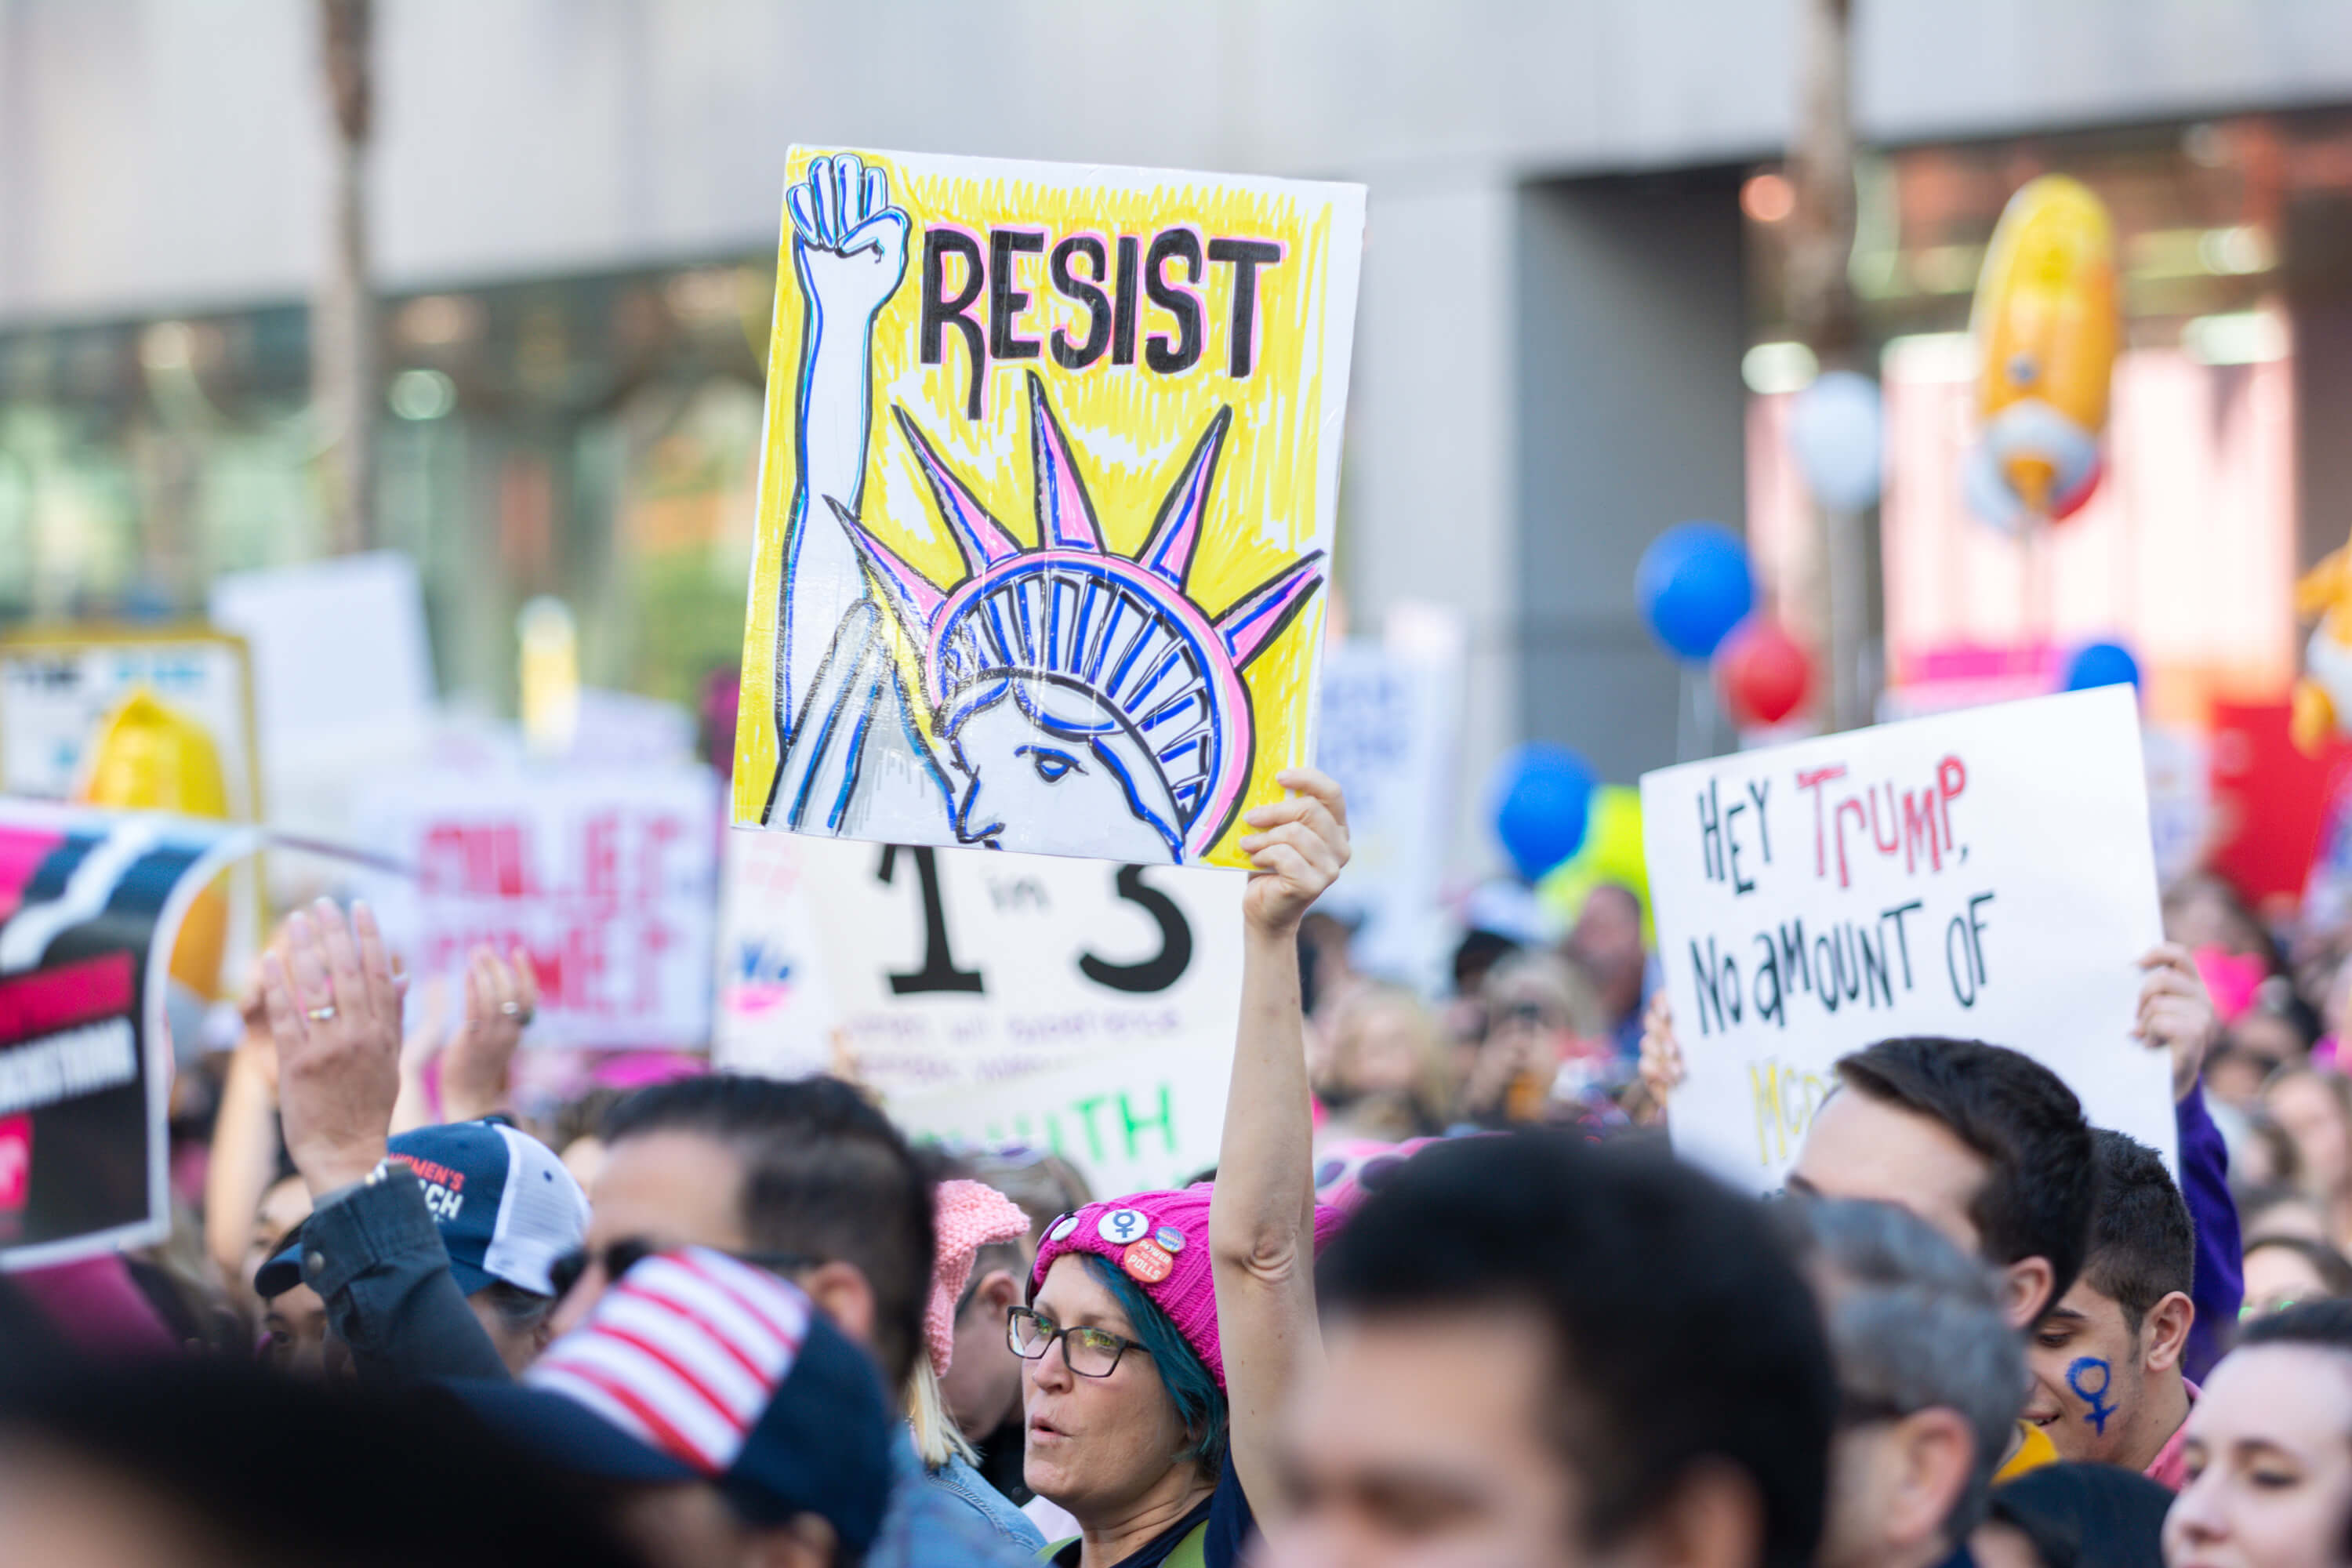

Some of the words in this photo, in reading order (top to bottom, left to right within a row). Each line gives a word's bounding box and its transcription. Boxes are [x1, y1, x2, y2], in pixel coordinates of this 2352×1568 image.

[920, 224, 1284, 421] RESIST
[1697, 776, 1772, 896] HEY
[877, 844, 985, 994] 1
[1946, 890, 1995, 1009] OF
[1127, 1254, 1161, 1280] POLLS
[1138, 1240, 1172, 1265] POWER
